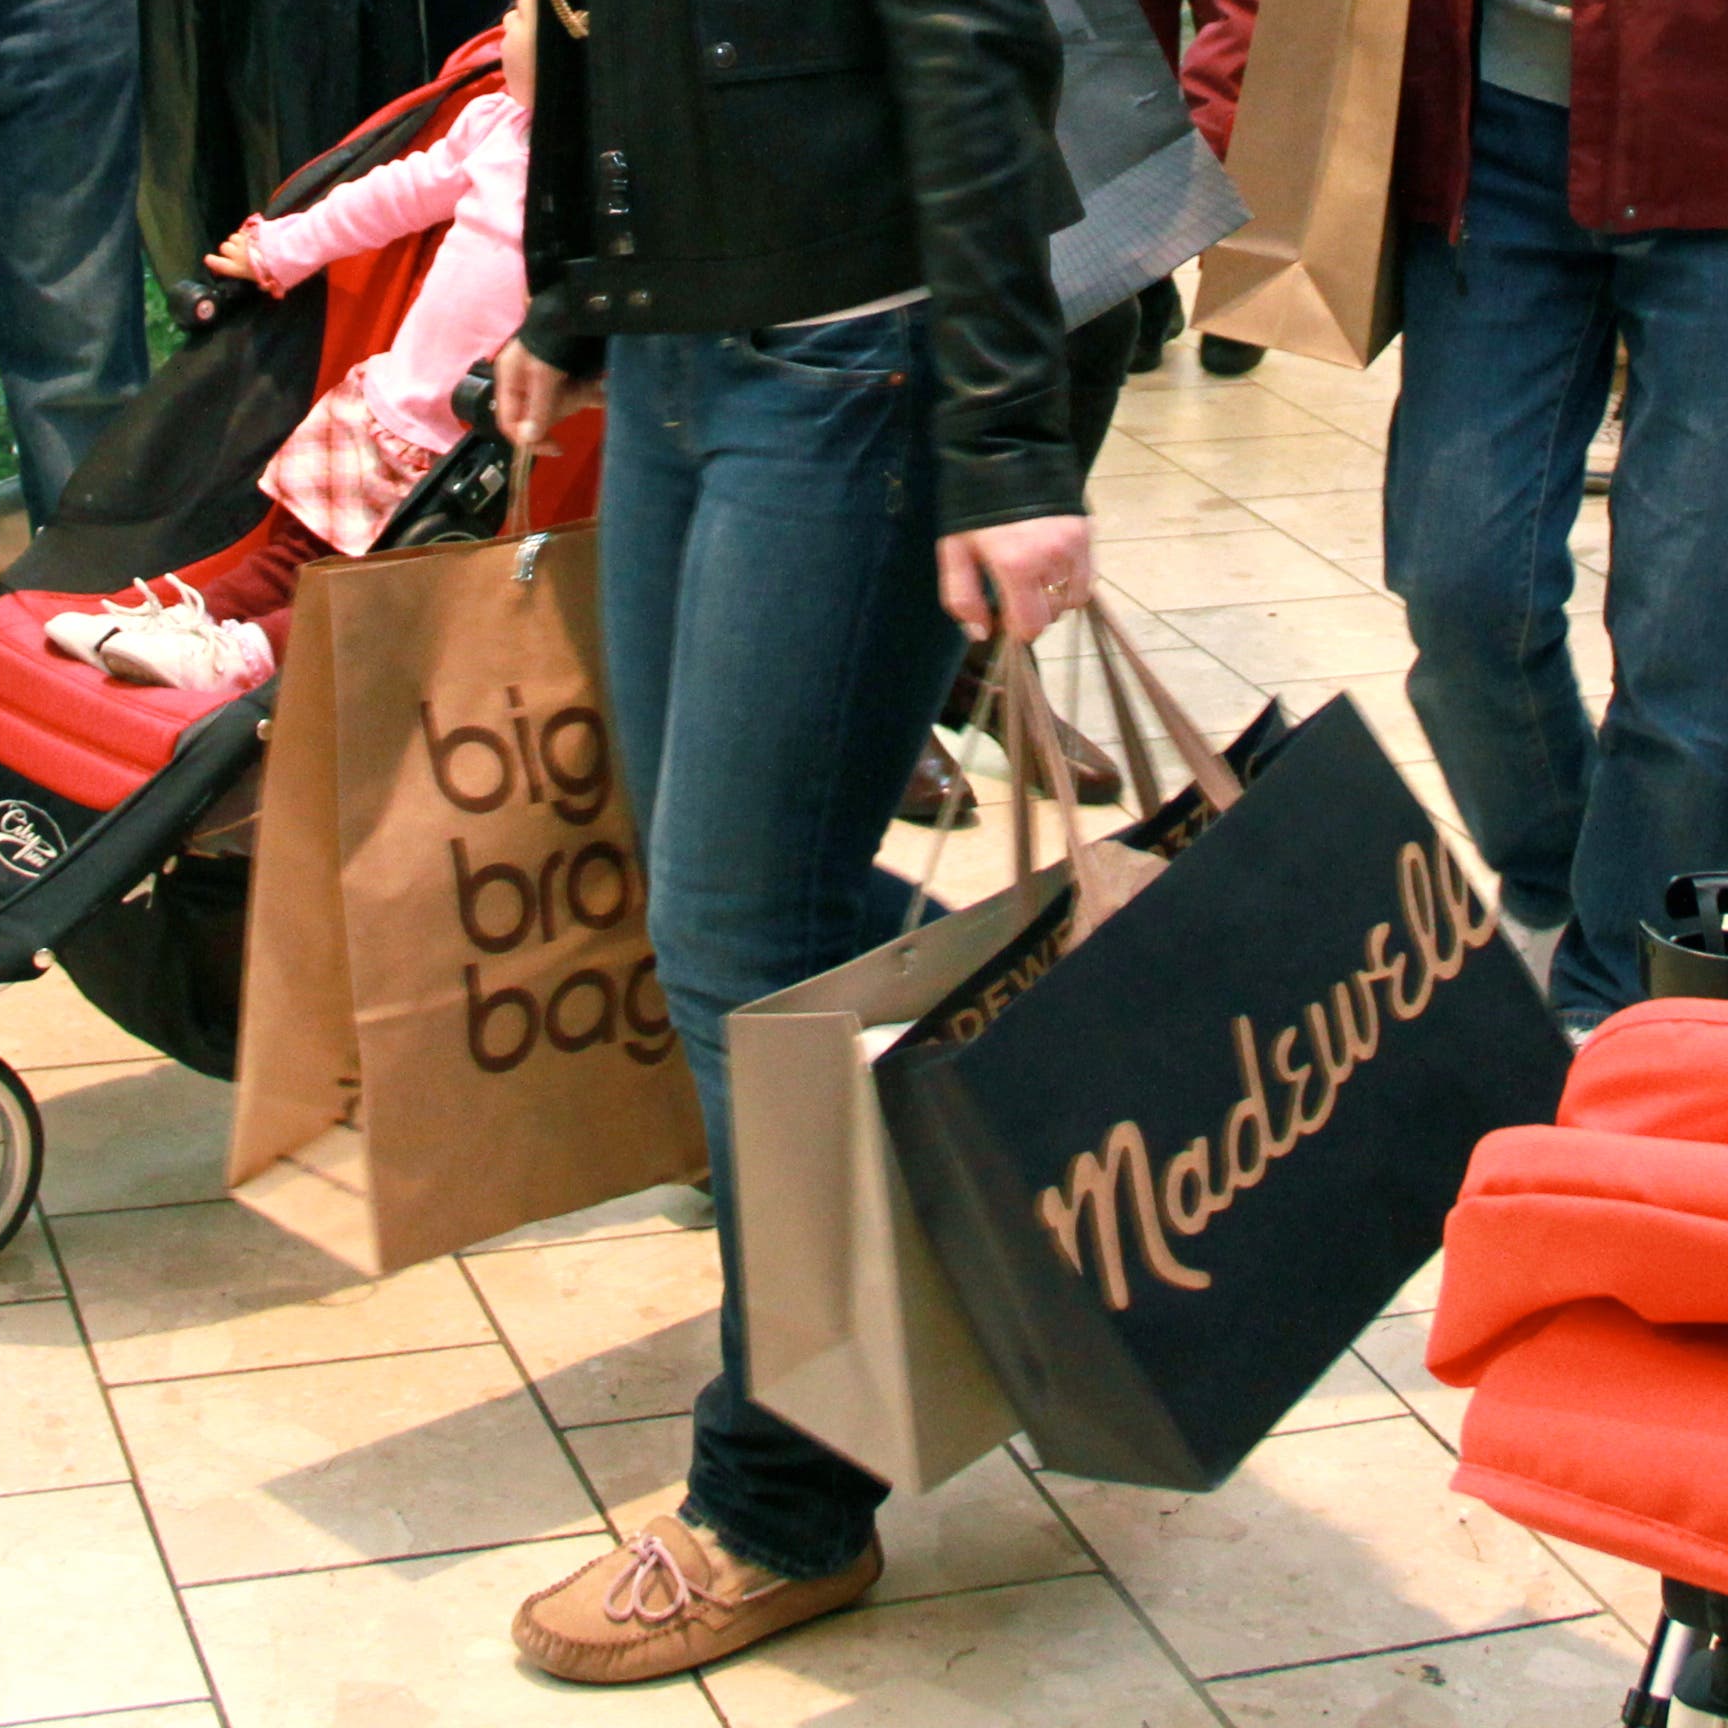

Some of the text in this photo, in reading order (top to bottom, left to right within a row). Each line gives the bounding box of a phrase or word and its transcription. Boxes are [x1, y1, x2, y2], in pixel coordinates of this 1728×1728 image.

[420, 685, 612, 826] big
[450, 835, 632, 955] bro
[463, 953, 676, 1074] bag
[1030, 838, 1501, 1313] Madewell
